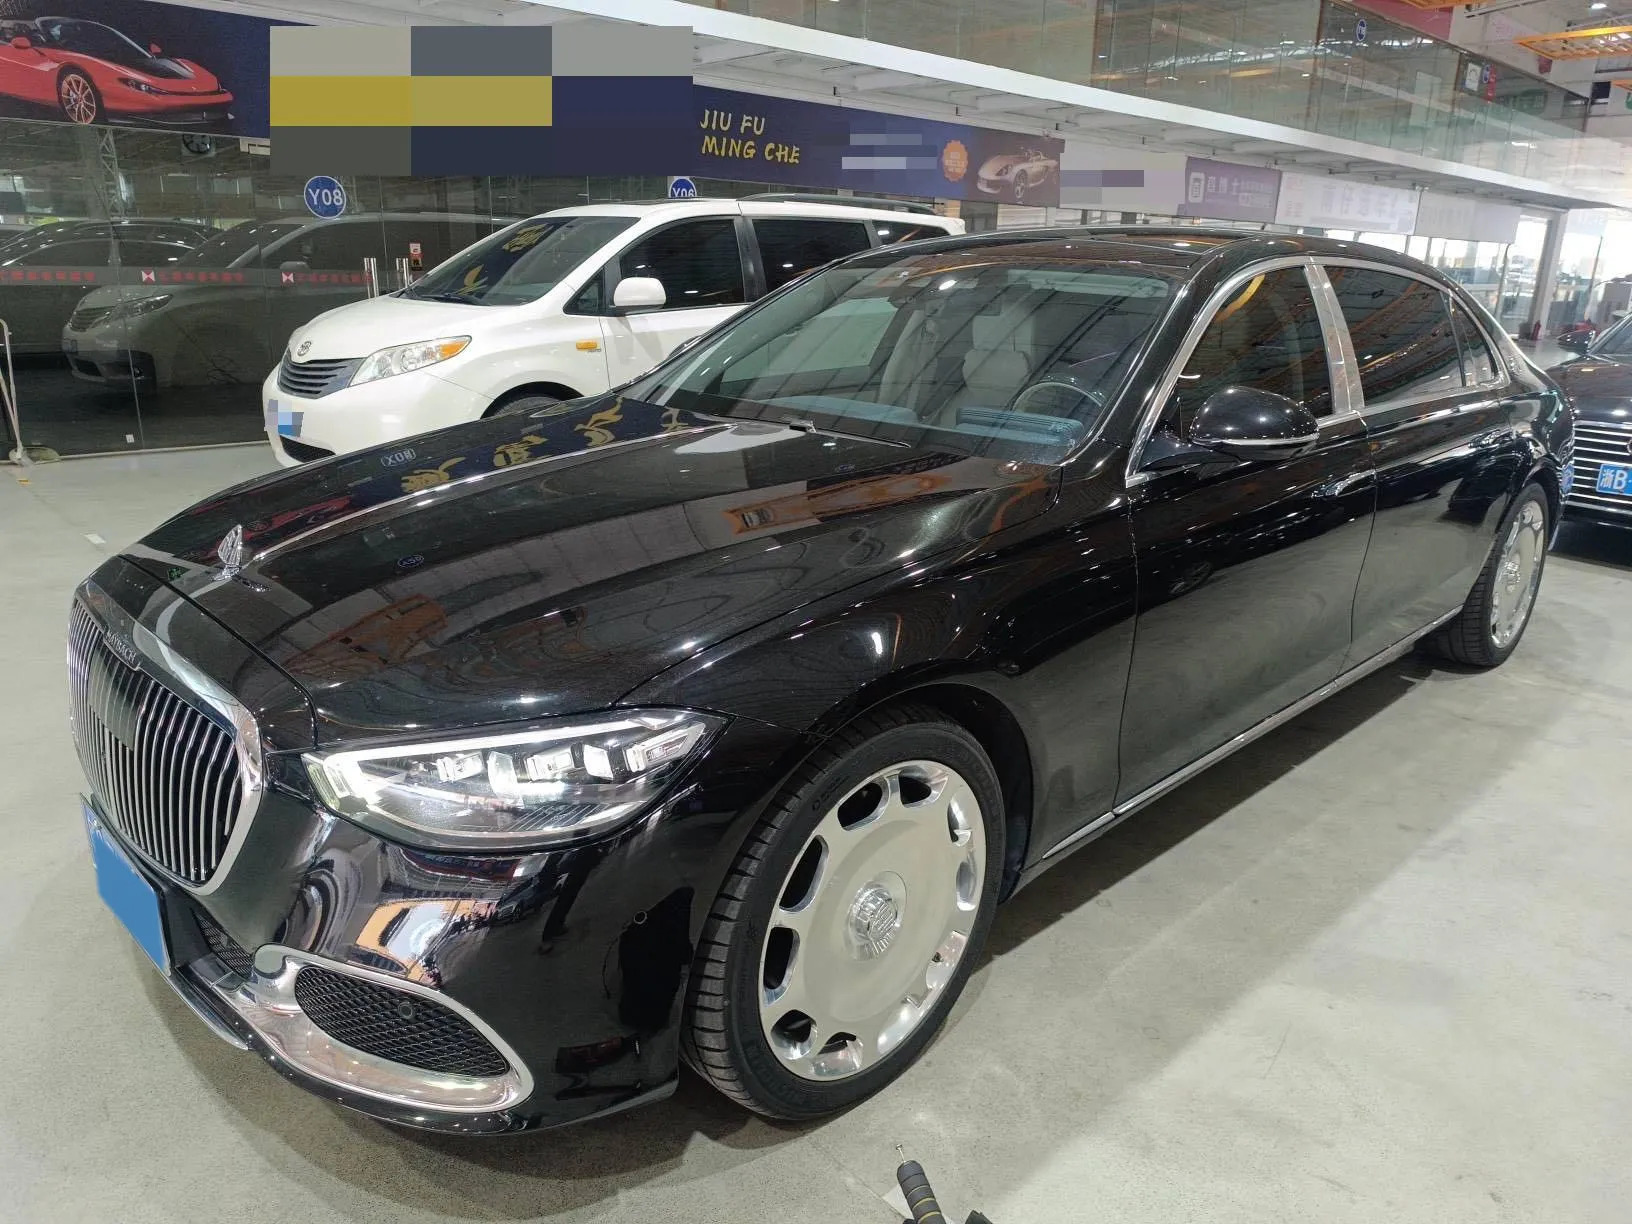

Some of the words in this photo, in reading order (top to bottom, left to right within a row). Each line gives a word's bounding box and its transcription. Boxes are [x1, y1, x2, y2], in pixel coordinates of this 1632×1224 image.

[700, 109, 732, 131] JIU
[740, 114, 766, 135] FU
[701, 135, 757, 159] MING
[764, 142, 800, 164] CHE
[308, 188, 343, 206] Y08
